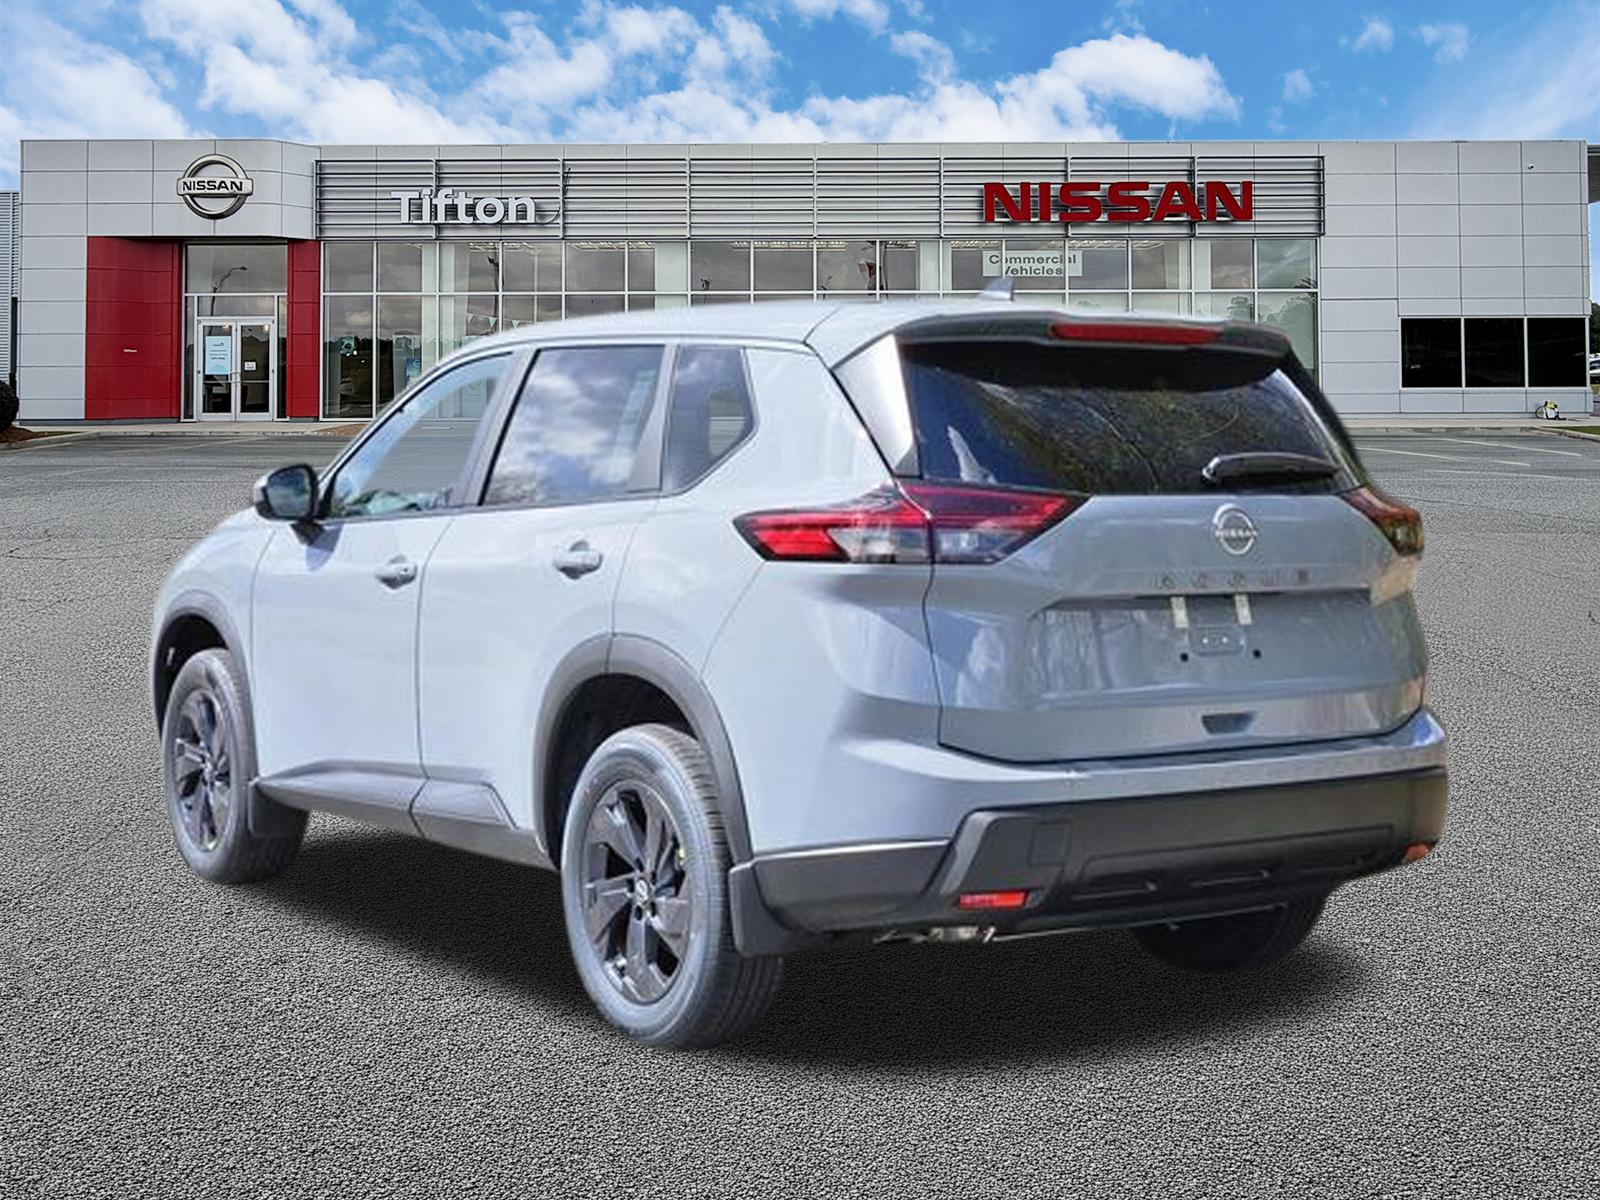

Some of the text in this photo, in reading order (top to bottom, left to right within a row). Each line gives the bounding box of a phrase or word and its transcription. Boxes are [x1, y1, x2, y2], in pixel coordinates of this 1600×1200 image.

[182, 180, 243, 191] NISSAN
[983, 181, 1253, 222] NISSAN
[391, 188, 536, 224] Tifton
